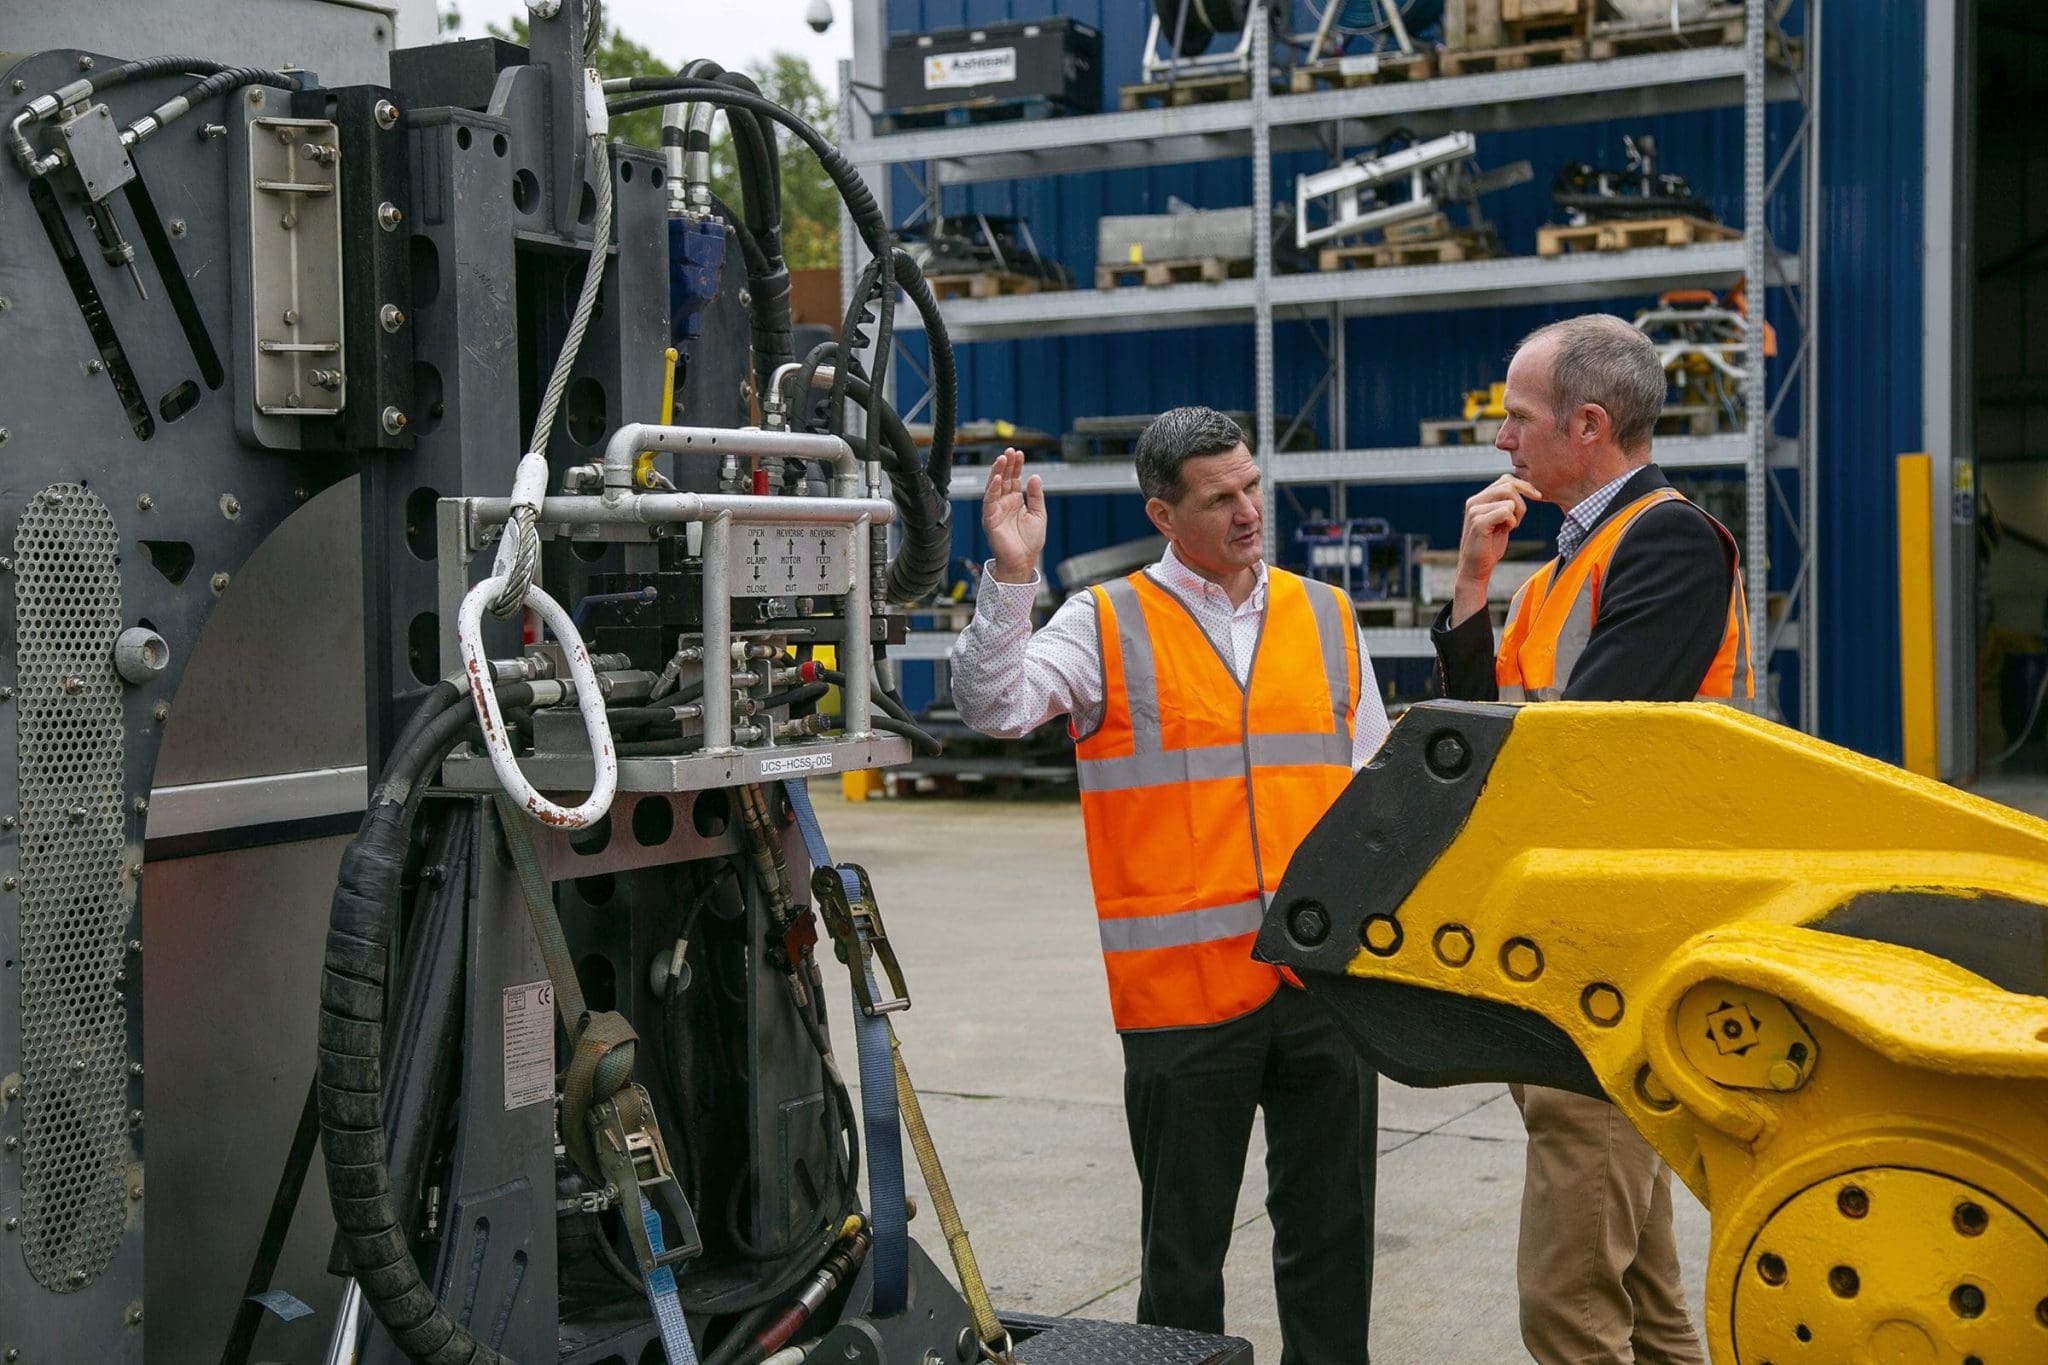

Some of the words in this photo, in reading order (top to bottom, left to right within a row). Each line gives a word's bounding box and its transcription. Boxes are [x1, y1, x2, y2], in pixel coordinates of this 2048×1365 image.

[748, 528, 765, 538] OPEN
[776, 528, 805, 538] REVERSE
[809, 528, 836, 538] REVERSE
[746, 556, 768, 565] CLAMP
[781, 556, 801, 565] MOTOR
[815, 556, 831, 564] FEED
[746, 584, 768, 594] CLOSE
[538, 986, 551, 1006] CE
